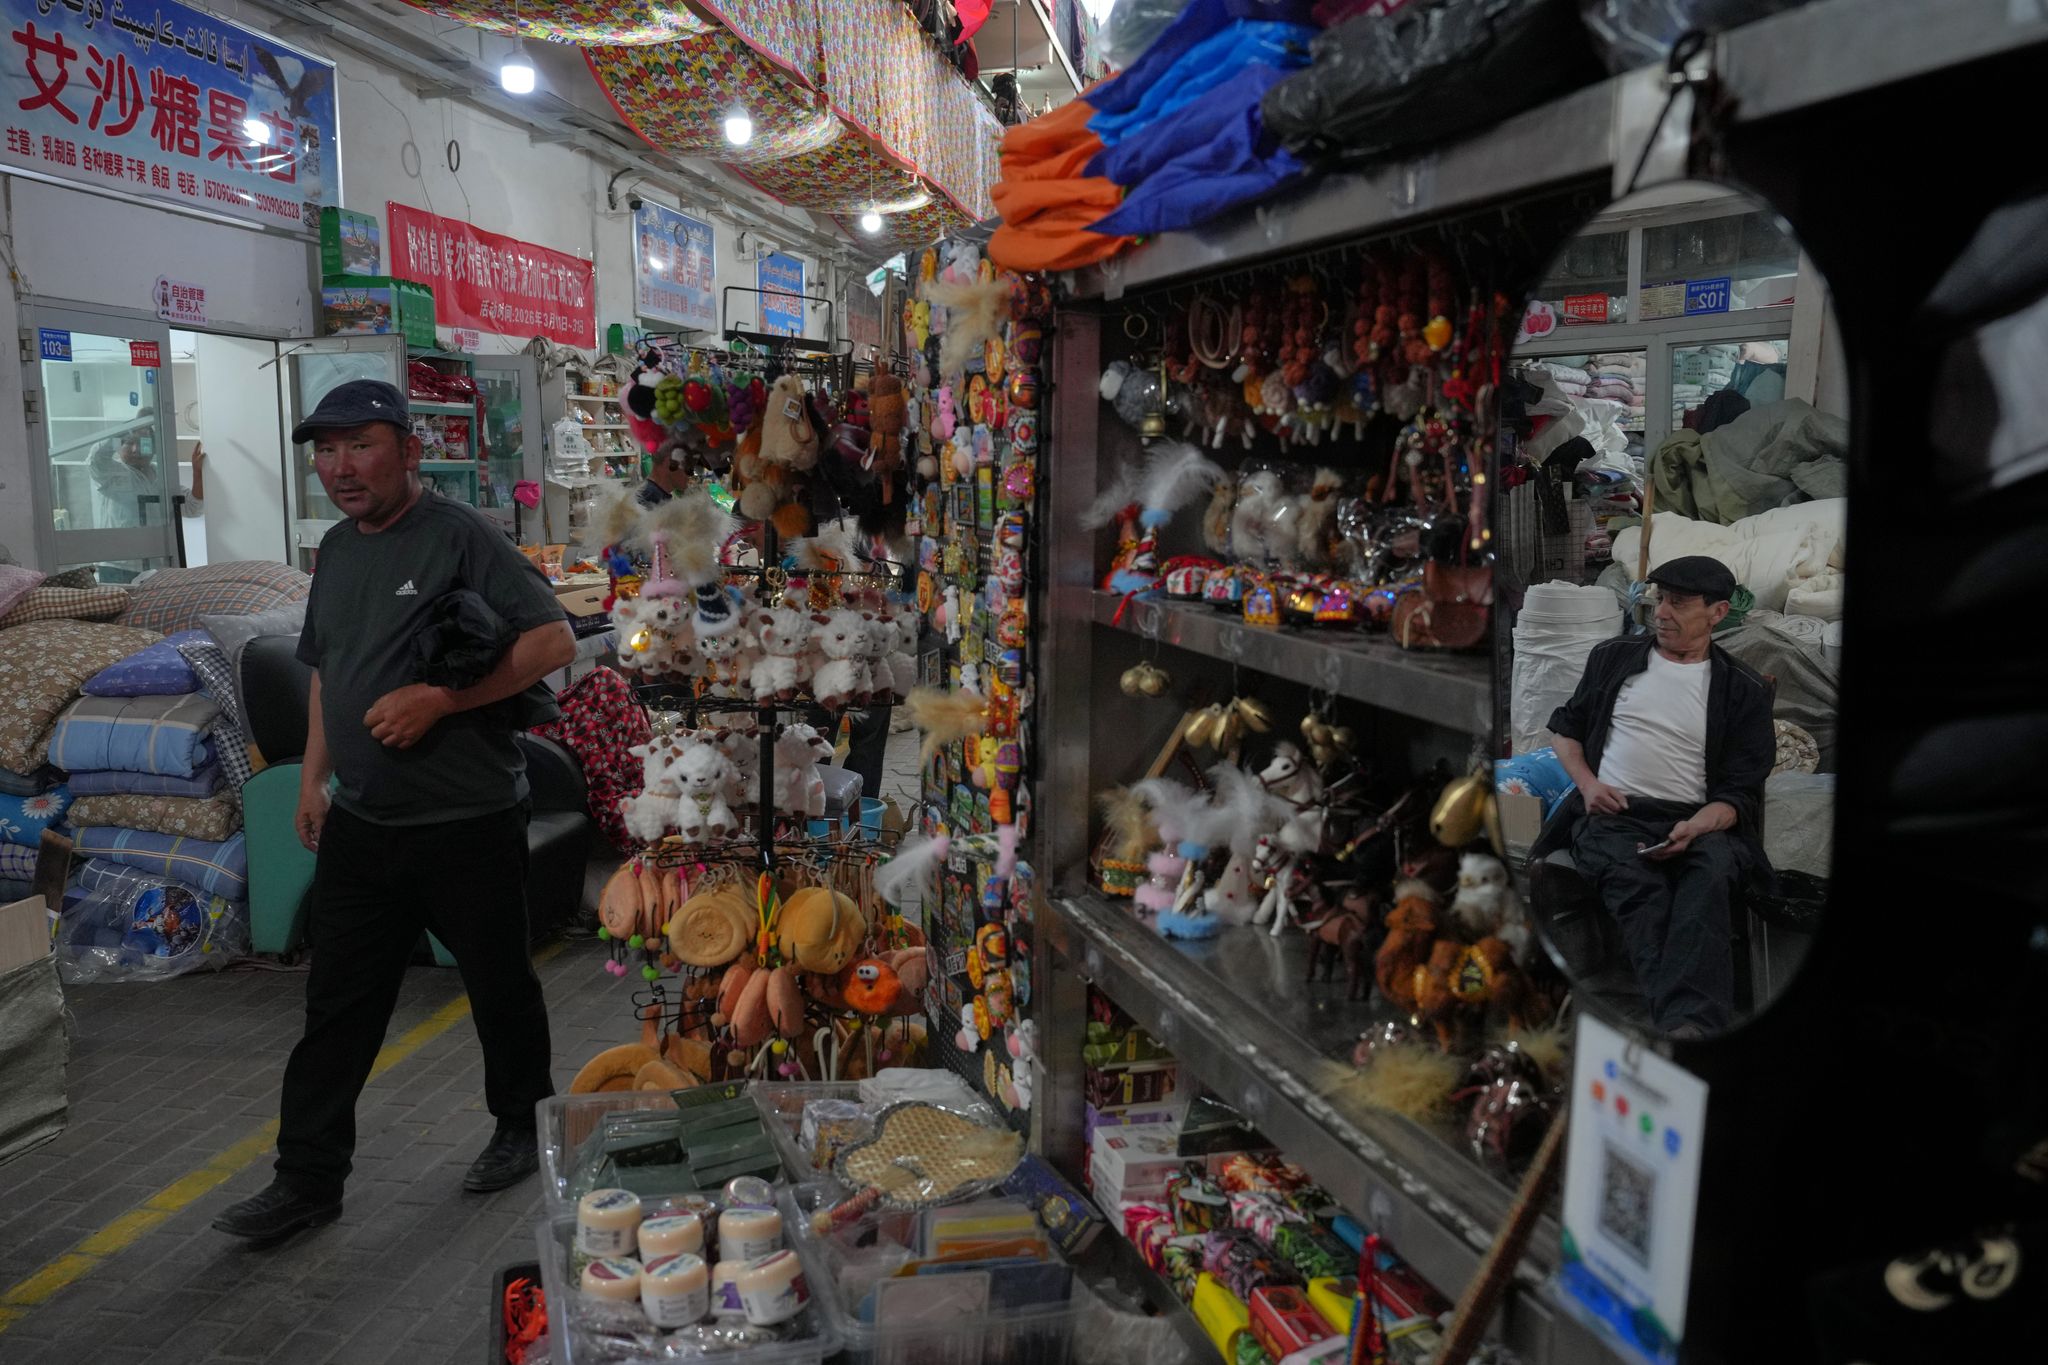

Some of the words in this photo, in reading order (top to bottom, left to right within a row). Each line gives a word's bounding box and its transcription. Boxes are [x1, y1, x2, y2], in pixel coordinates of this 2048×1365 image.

[12, 21, 297, 185] 艾沙糖果店
[42, 135, 77, 167] 乳制品
[82, 145, 124, 179] 各种糖果
[151, 163, 171, 190] 食品
[254, 192, 300, 219] 15009062328
[172, 285, 205, 302] 自治管理
[176, 299, 201, 314] 带头人
[43, 340, 62, 356] 103
